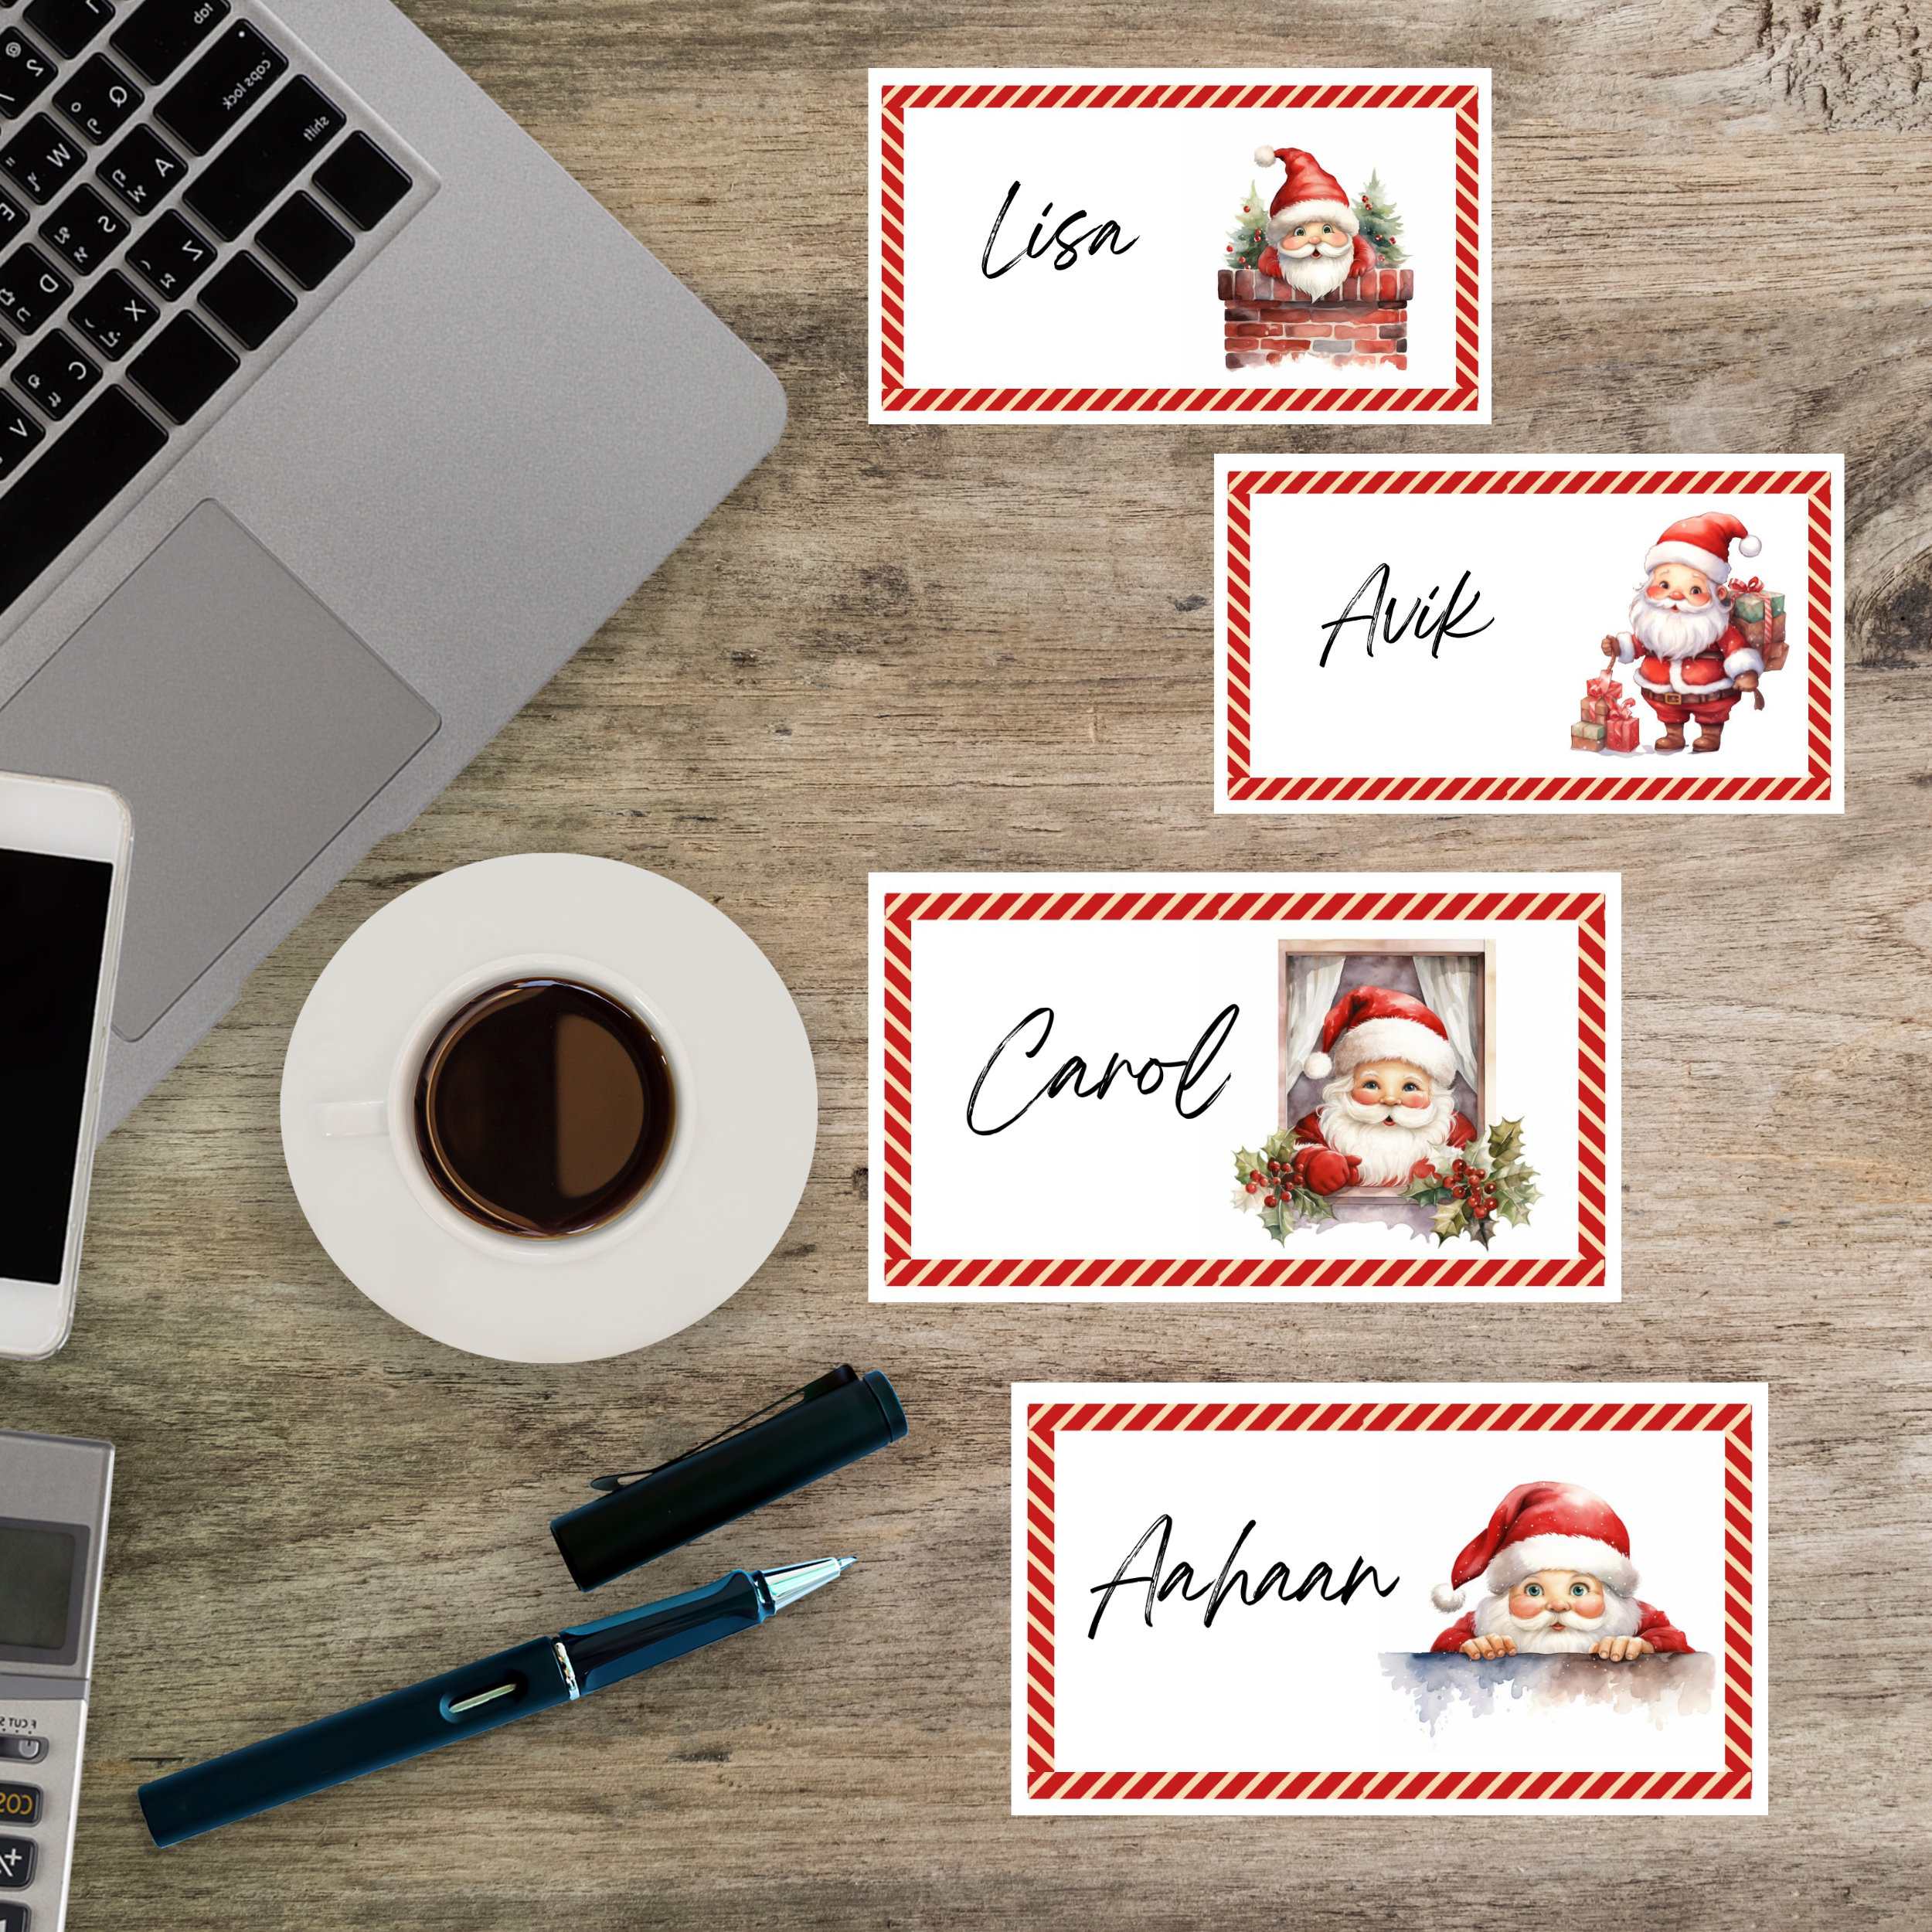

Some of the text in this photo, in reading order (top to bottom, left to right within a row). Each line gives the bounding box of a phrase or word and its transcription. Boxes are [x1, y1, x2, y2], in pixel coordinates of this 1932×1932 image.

[981, 180, 1140, 279] Lisa
[1320, 563, 1495, 668] Avik
[966, 1003, 1240, 1136] Carol
[1087, 1513, 1400, 1640] Aahaan
